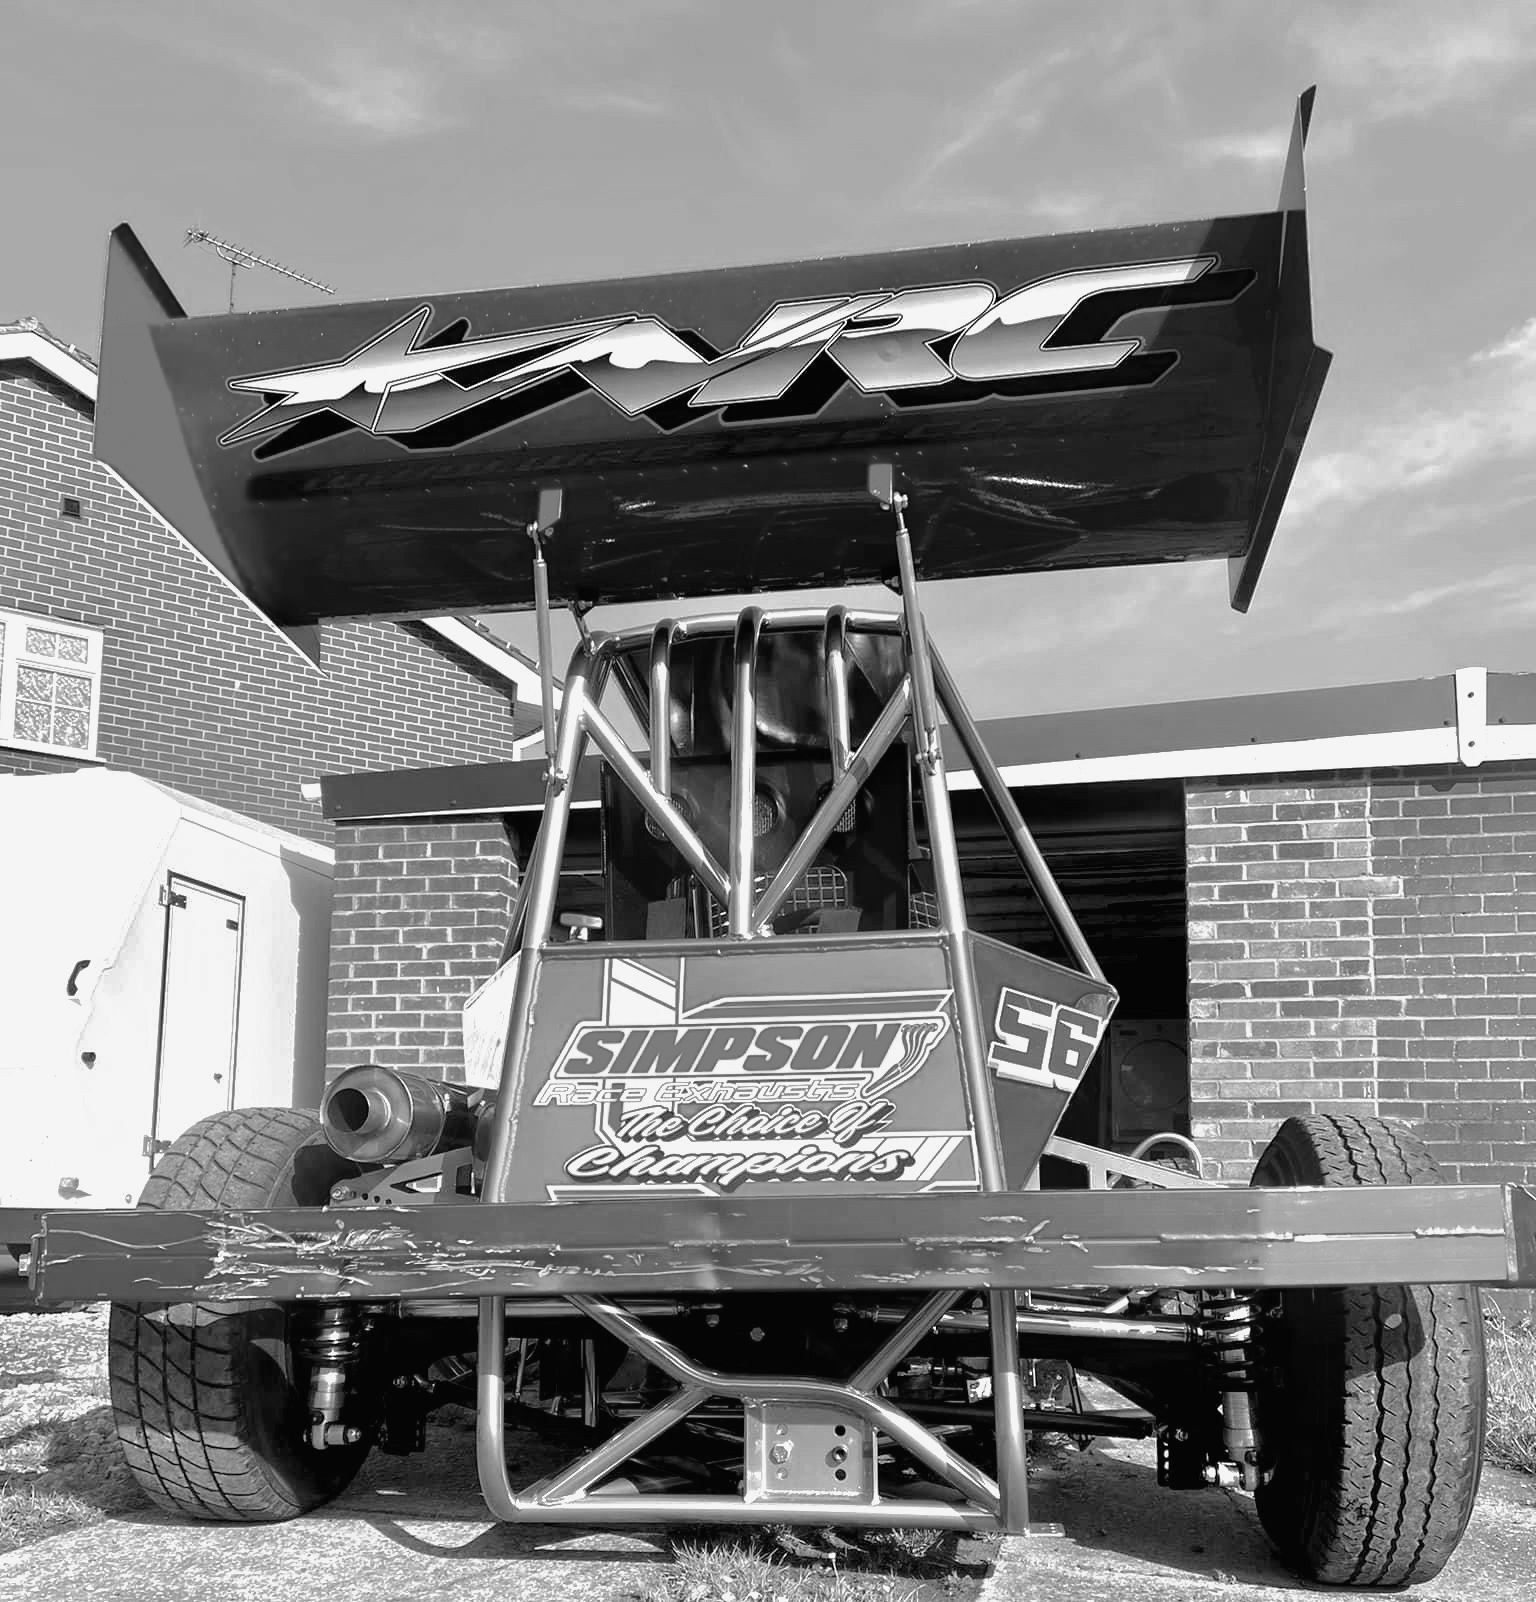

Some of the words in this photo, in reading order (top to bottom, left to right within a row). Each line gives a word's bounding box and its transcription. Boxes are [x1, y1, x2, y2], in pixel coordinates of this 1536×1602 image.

[563, 1022, 902, 1074] SIMPSON
[988, 987, 1103, 1088] 56
[537, 1081, 648, 1106] Race
[654, 1078, 860, 1104] Exhausts
[615, 1104, 689, 1142] The
[687, 1102, 831, 1142] Choice
[829, 1100, 897, 1147] Of
[564, 1144, 916, 1192] Champions
